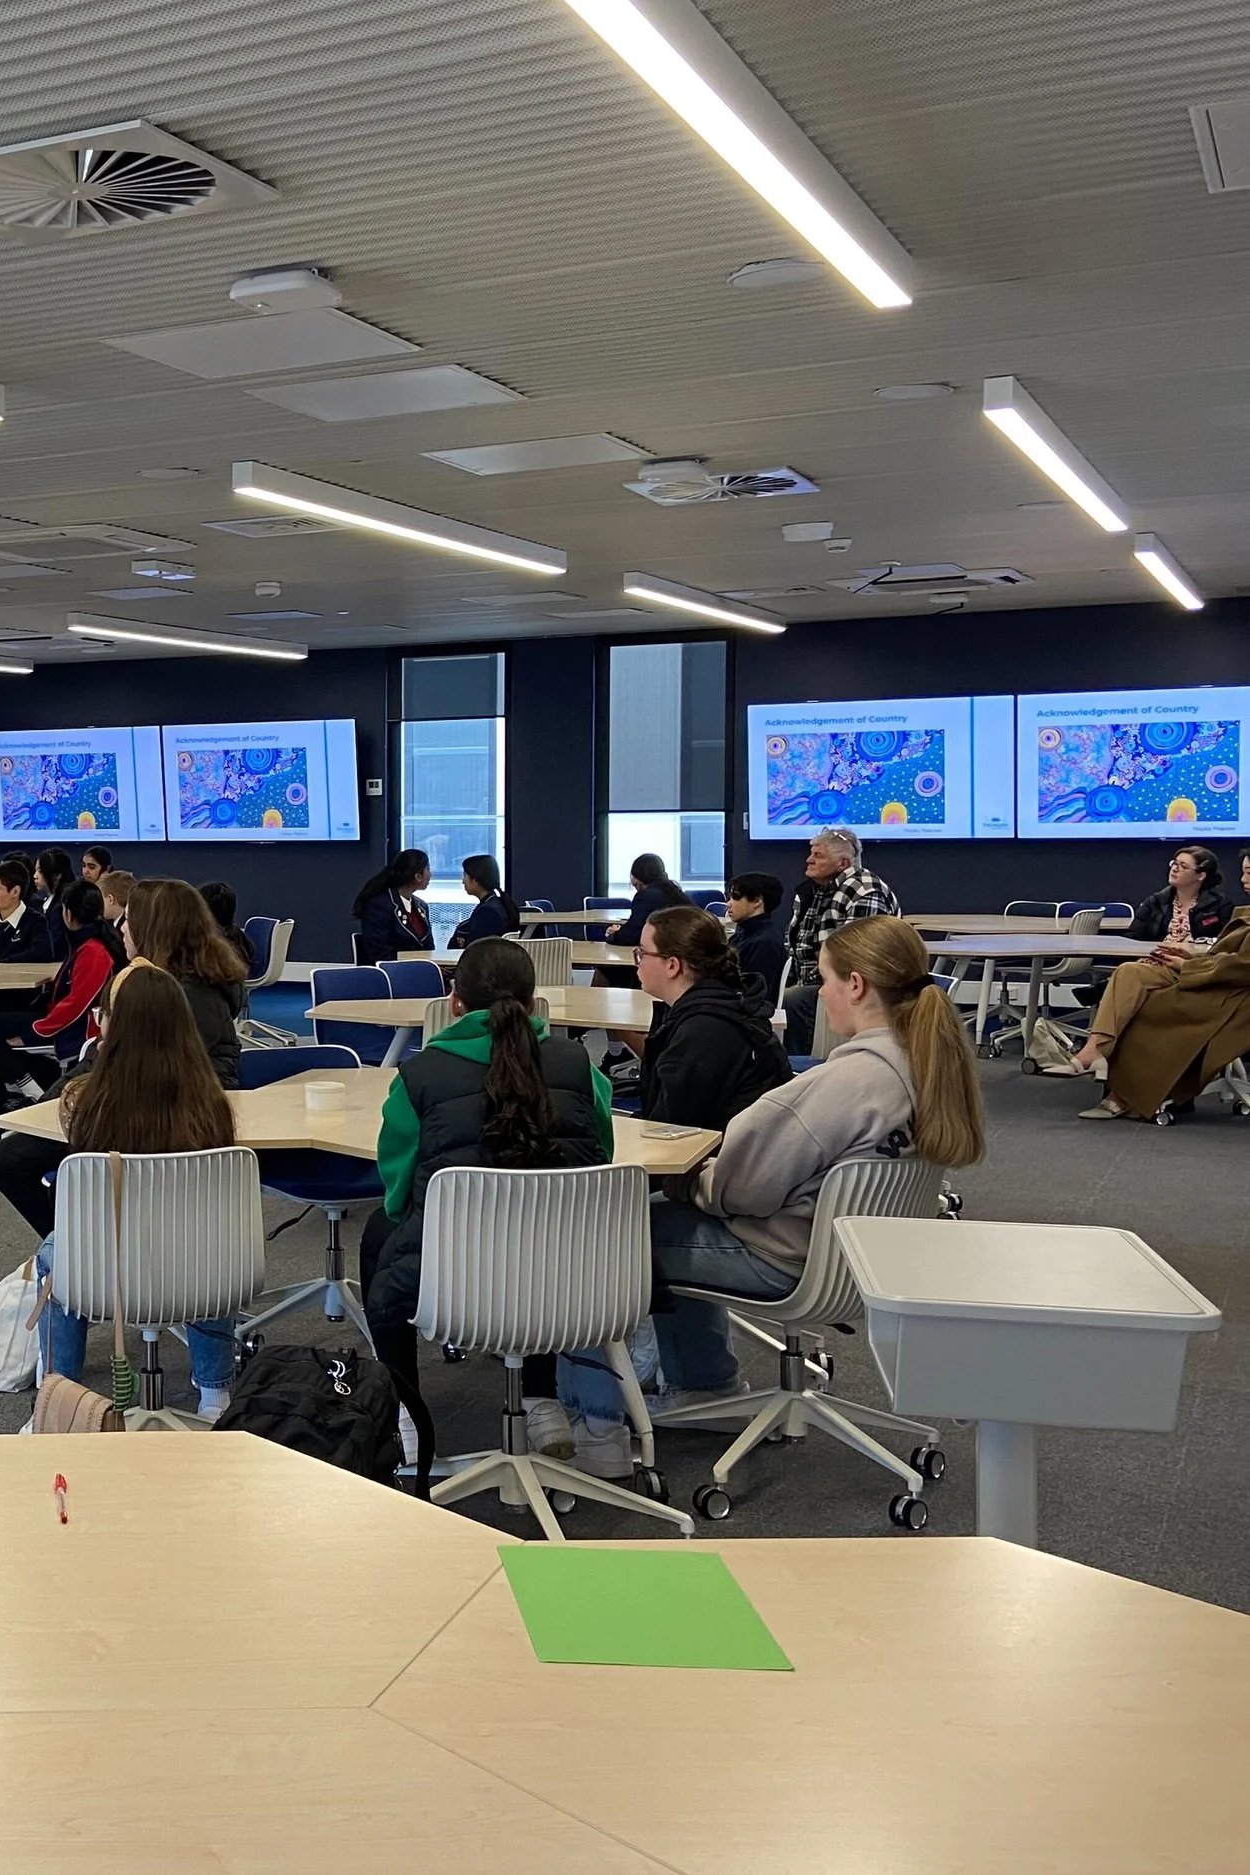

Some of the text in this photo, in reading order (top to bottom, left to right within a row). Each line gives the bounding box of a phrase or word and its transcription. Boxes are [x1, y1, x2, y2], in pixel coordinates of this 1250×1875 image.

[1036, 705, 1199, 718] Acknowledgement of Country
[764, 715, 908, 727] Acknowledgement of Country
